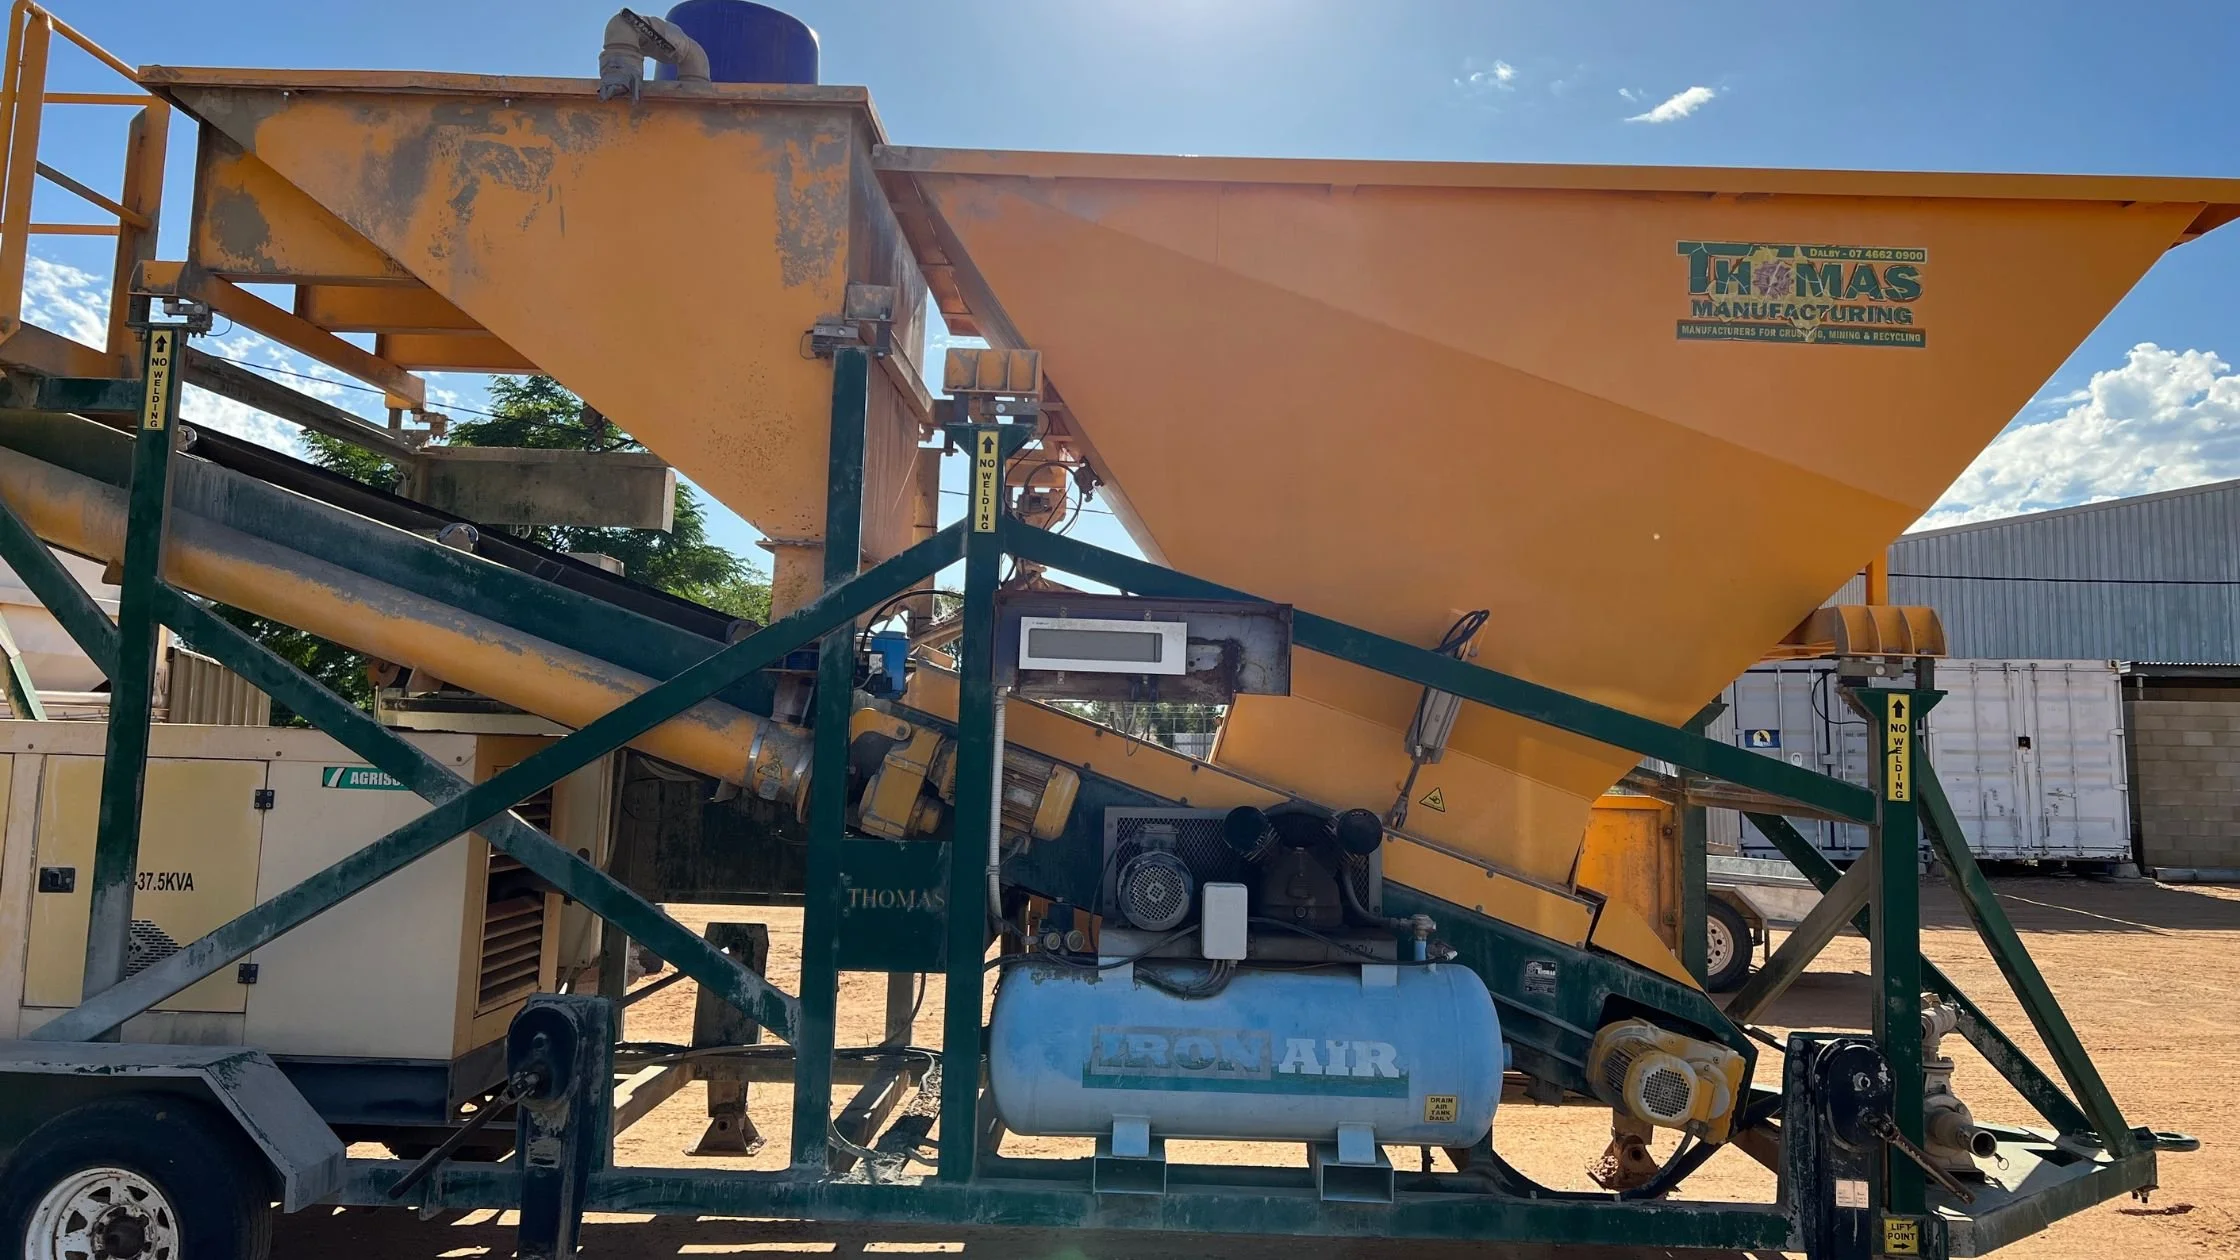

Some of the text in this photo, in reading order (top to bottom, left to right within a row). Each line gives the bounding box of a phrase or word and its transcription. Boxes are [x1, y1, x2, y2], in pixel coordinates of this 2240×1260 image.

[1809, 248, 1840, 258] DALBY
[1848, 249, 1862, 258] 07
[1865, 249, 1893, 260] 4662
[1895, 251, 1923, 260] 0900
[1692, 300, 1914, 325] MANUFACTURING
[1681, 325, 1757, 337] MANUFACTURERS
[1759, 328, 1777, 337] FOR
[1829, 330, 1861, 341] MINING
[1863, 333, 1871, 341] &
[1873, 333, 1921, 343] RECYCLING
[150, 358, 167, 428] NO WELDING
[979, 459, 996, 530] NO WELDING
[1890, 723, 1907, 799] NO WELDING
[349, 771, 405, 787] AGRIS
[848, 888, 946, 909] THOMAS
[1278, 1038, 1400, 1078] AIR
[1887, 1232, 1916, 1241] POINT
[1891, 1223, 1912, 1231] LIFT
